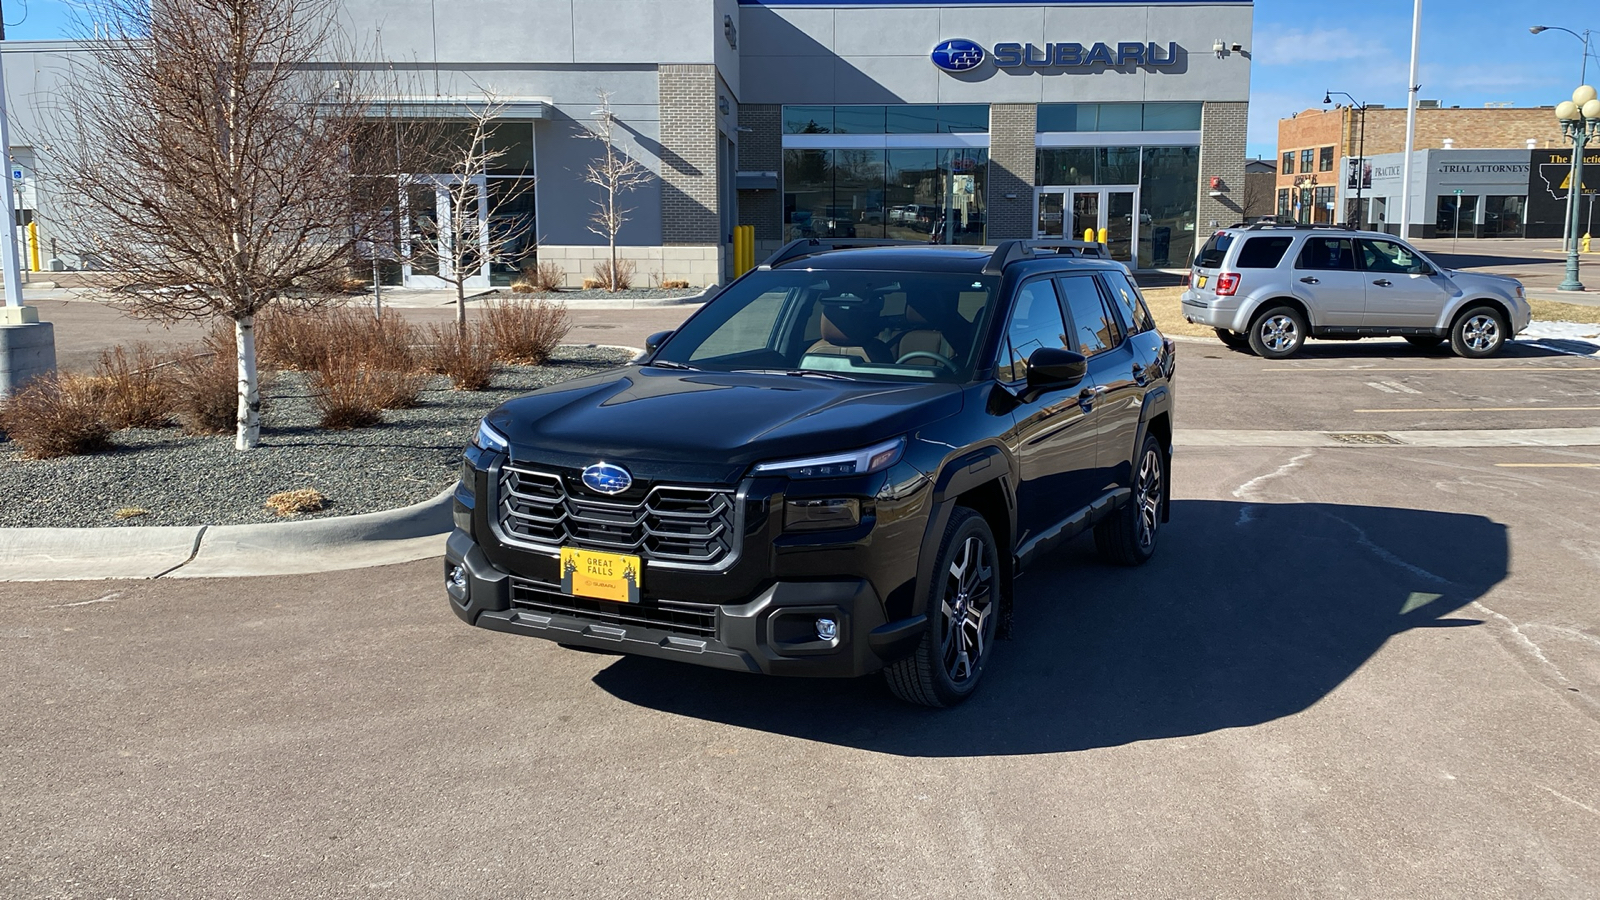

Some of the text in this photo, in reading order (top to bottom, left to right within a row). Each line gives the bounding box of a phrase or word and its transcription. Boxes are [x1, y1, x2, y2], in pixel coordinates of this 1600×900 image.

[992, 42, 1177, 66] SUBARU
[1549, 154, 1568, 164] The
[1375, 166, 1400, 177] PRACTICE
[1443, 164, 1530, 173] TRIAL ATTORNEYS
[587, 557, 613, 567] GREAT
[587, 566, 613, 576] FALLS
